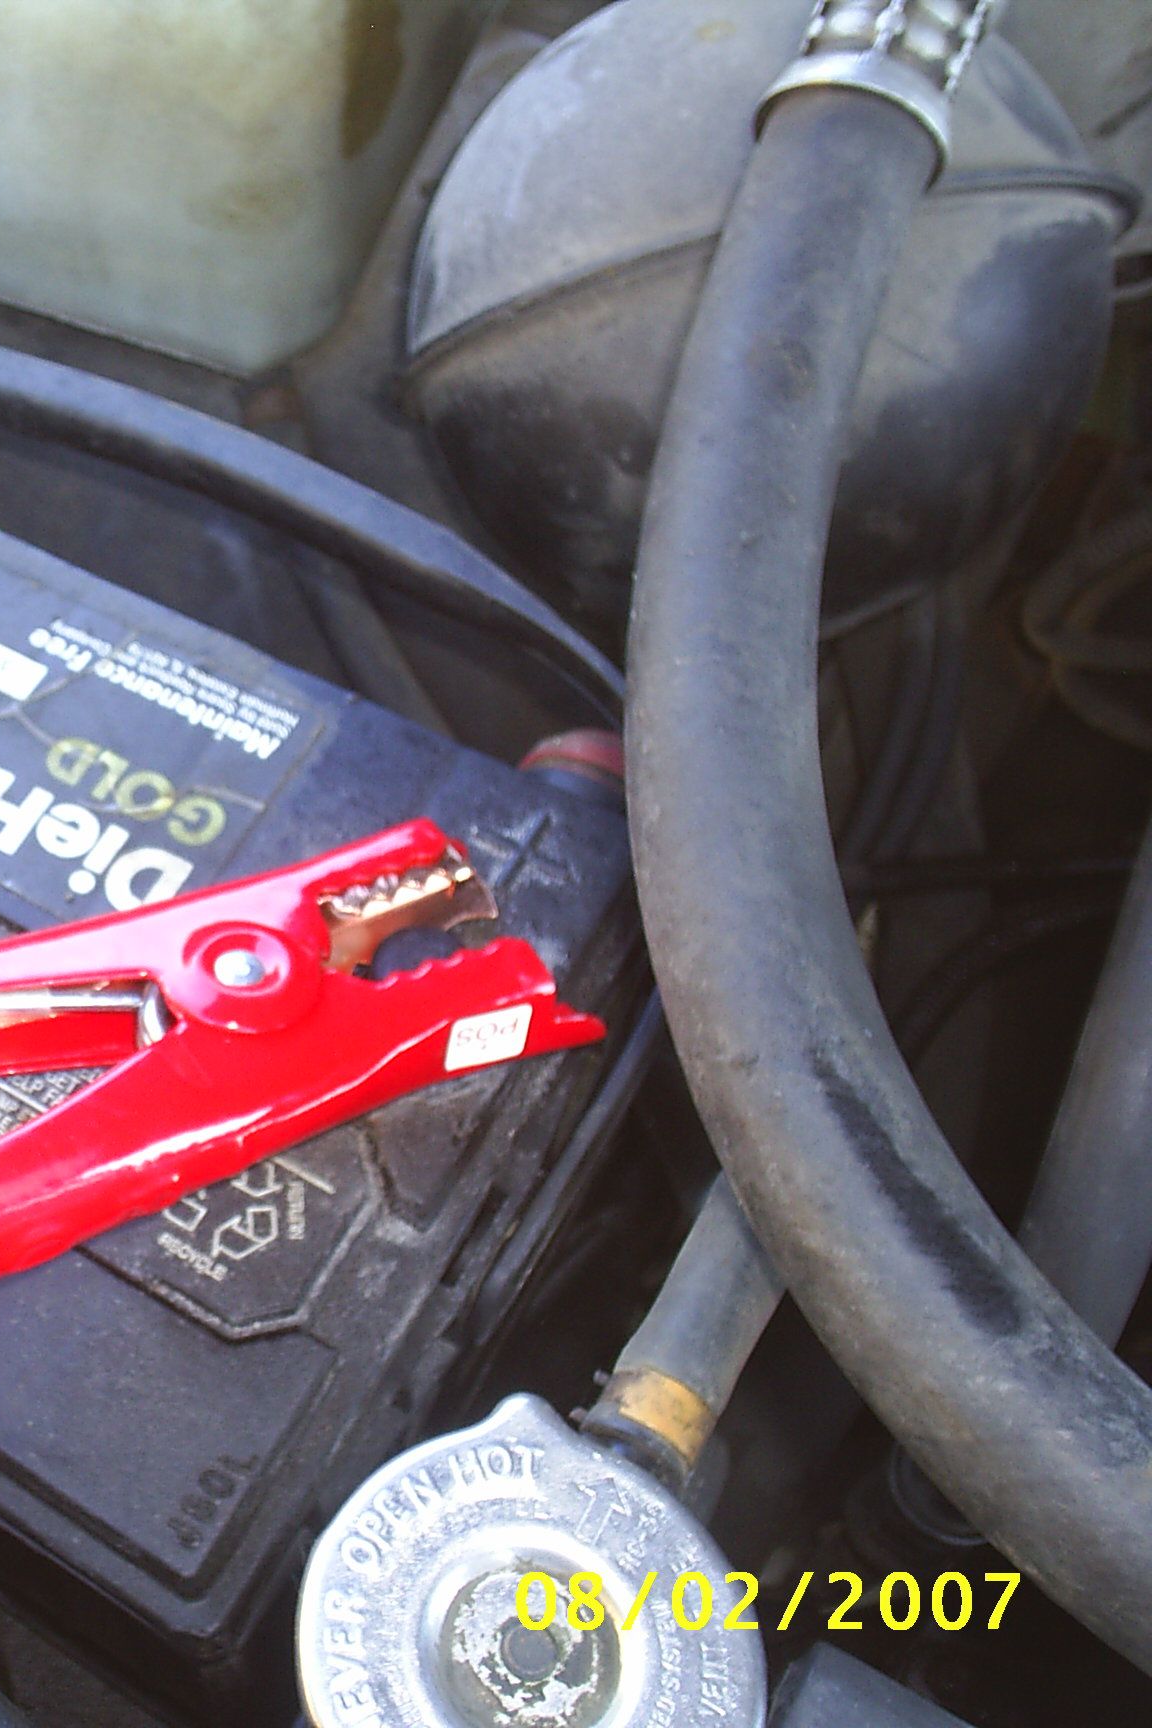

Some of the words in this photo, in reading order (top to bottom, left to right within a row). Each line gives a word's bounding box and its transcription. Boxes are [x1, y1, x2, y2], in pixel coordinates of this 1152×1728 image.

[28, 628, 93, 673] Free
[95, 658, 282, 760] Maintenance
[47, 737, 227, 846] GOLD
[455, 1017, 518, 1048] POS
[157, 1231, 229, 1283] RECYCLE
[341, 1468, 452, 1582] OPEN
[448, 1445, 546, 1494] HOT
